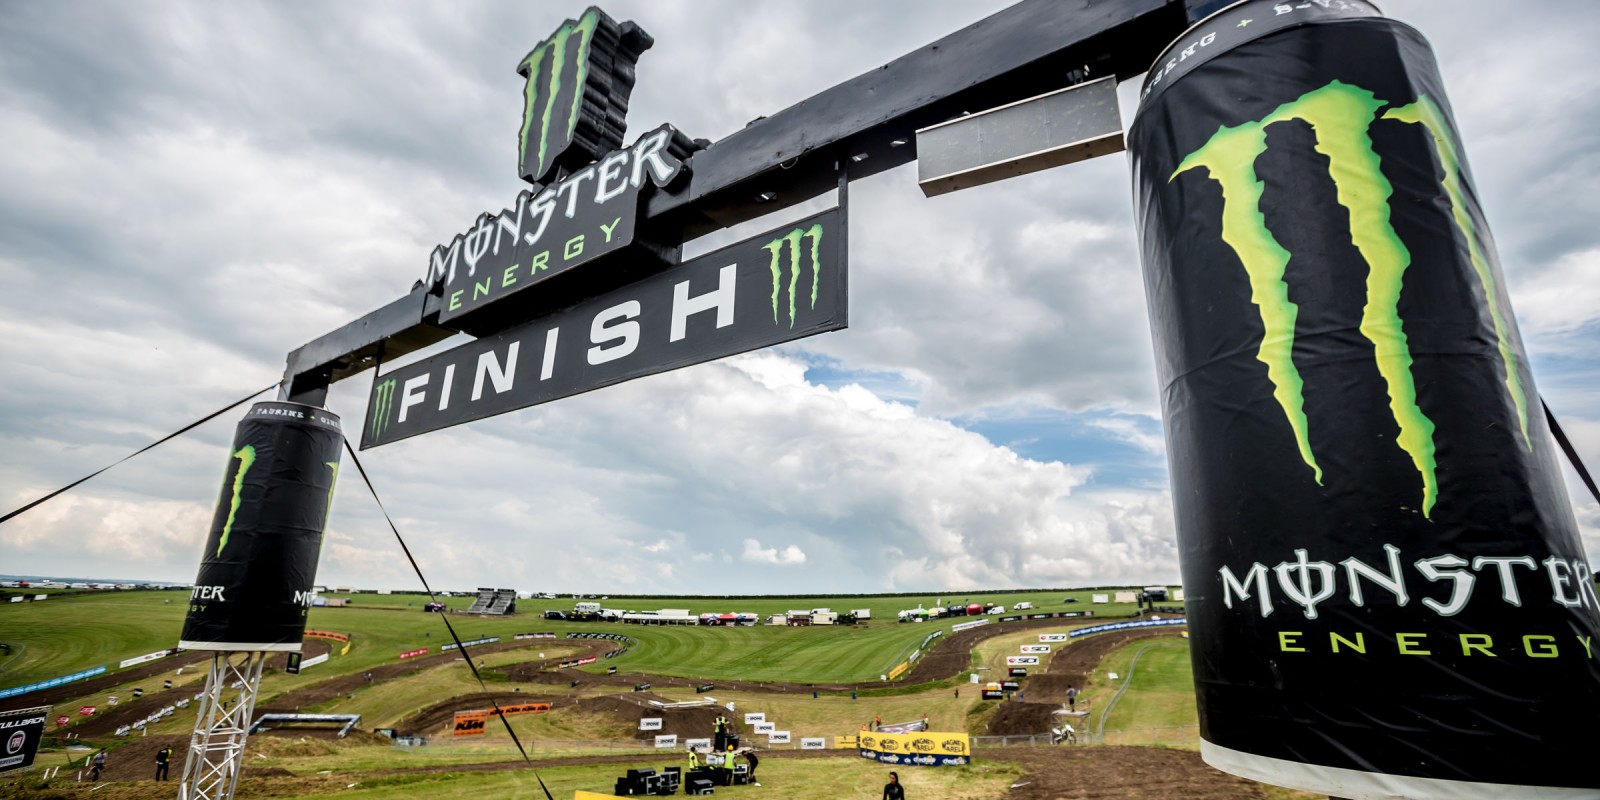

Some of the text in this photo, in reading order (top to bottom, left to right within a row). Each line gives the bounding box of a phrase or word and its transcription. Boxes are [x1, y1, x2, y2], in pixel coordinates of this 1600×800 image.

[427, 129, 676, 287] MONSTER
[449, 216, 621, 312] ENERGY
[397, 263, 738, 424] FINISH
[256, 408, 304, 419] TAURINE
[1218, 543, 1600, 620] MONSTER
[1277, 631, 1592, 660] ENERGY
[455, 719, 485, 731] KTM
